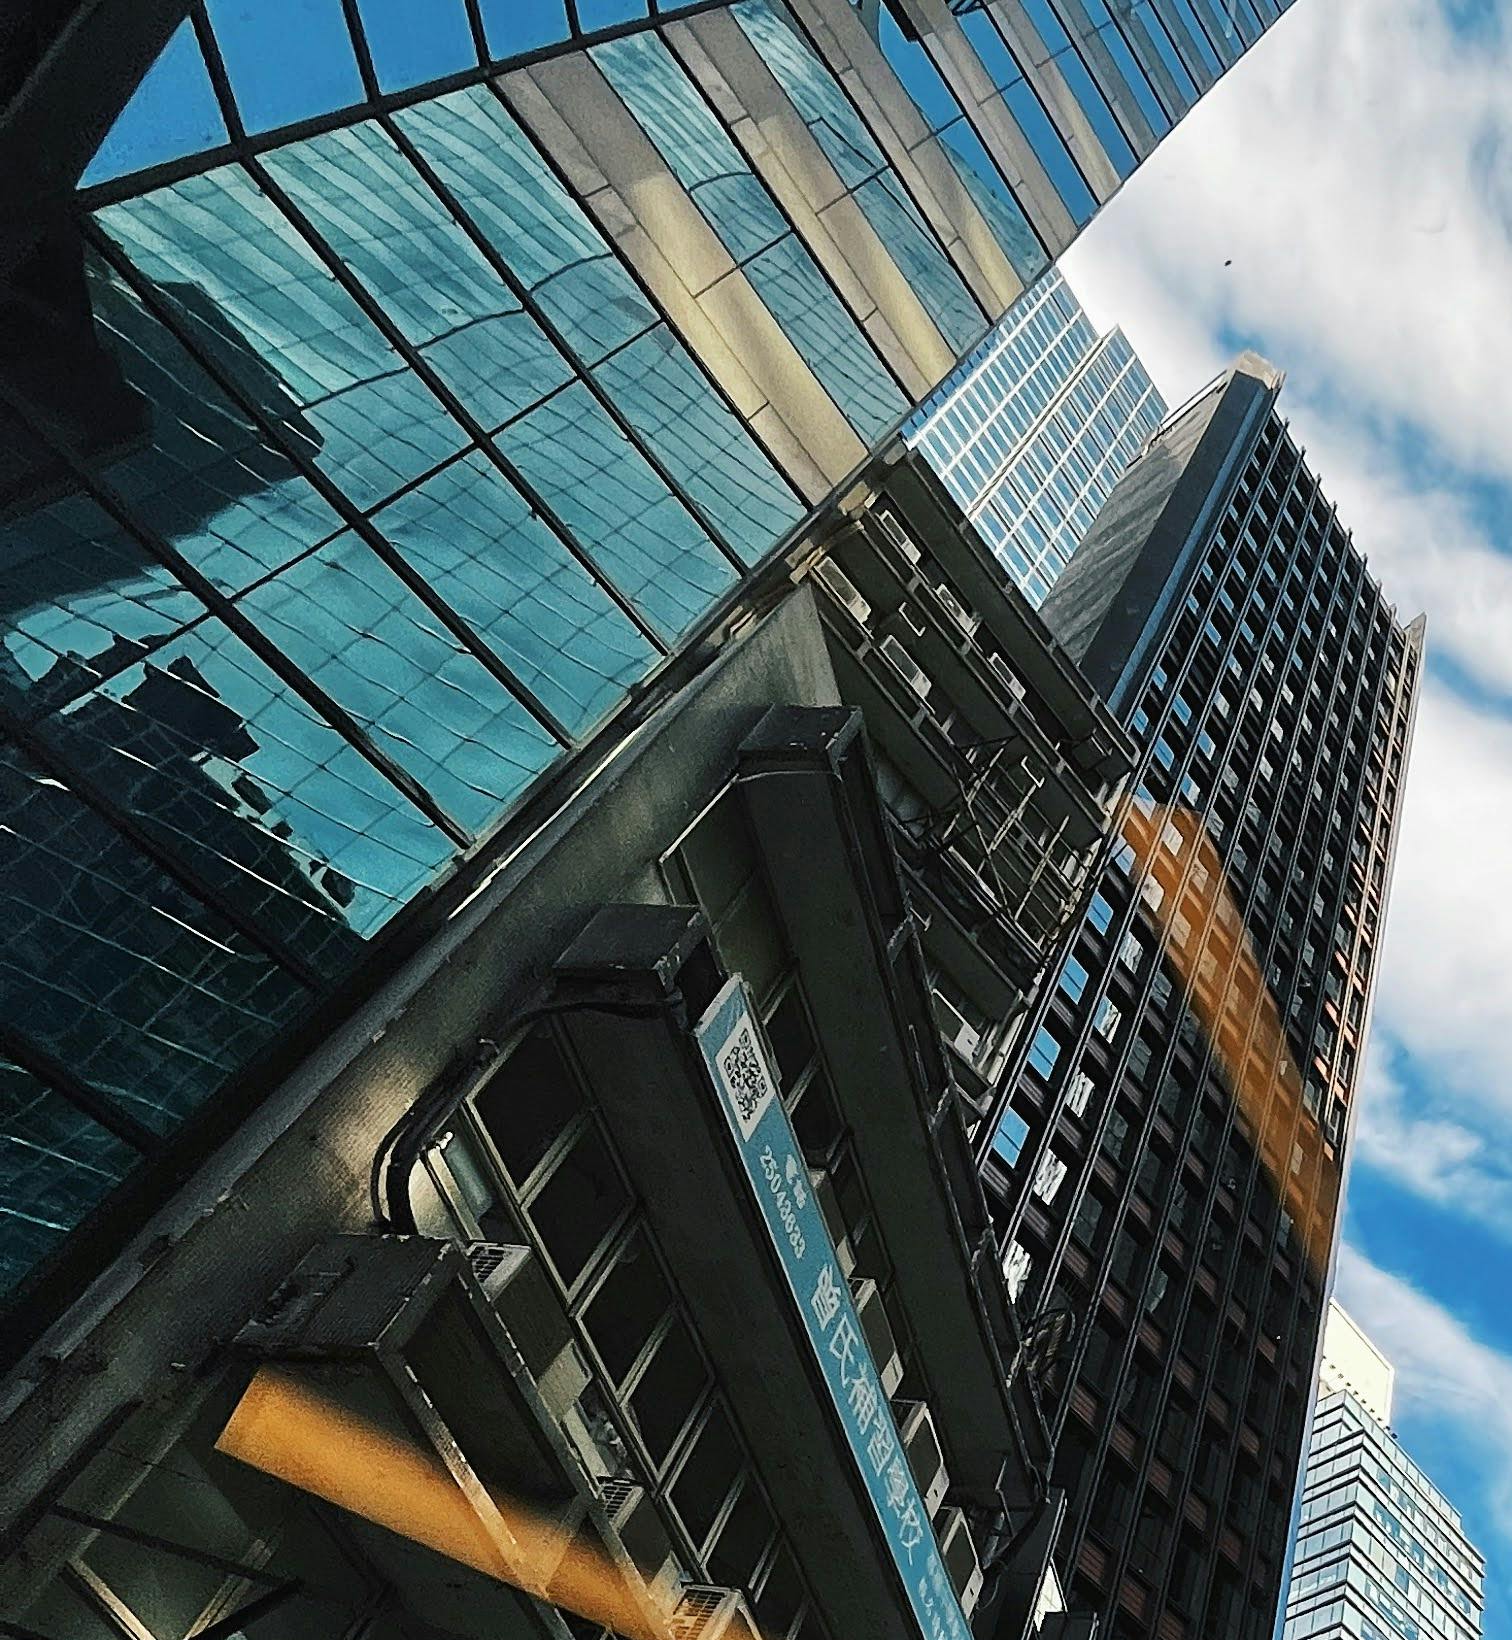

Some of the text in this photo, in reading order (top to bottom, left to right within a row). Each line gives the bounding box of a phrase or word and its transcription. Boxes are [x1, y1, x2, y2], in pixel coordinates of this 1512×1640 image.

[810, 1263, 923, 1566] 曾氏補習學校
